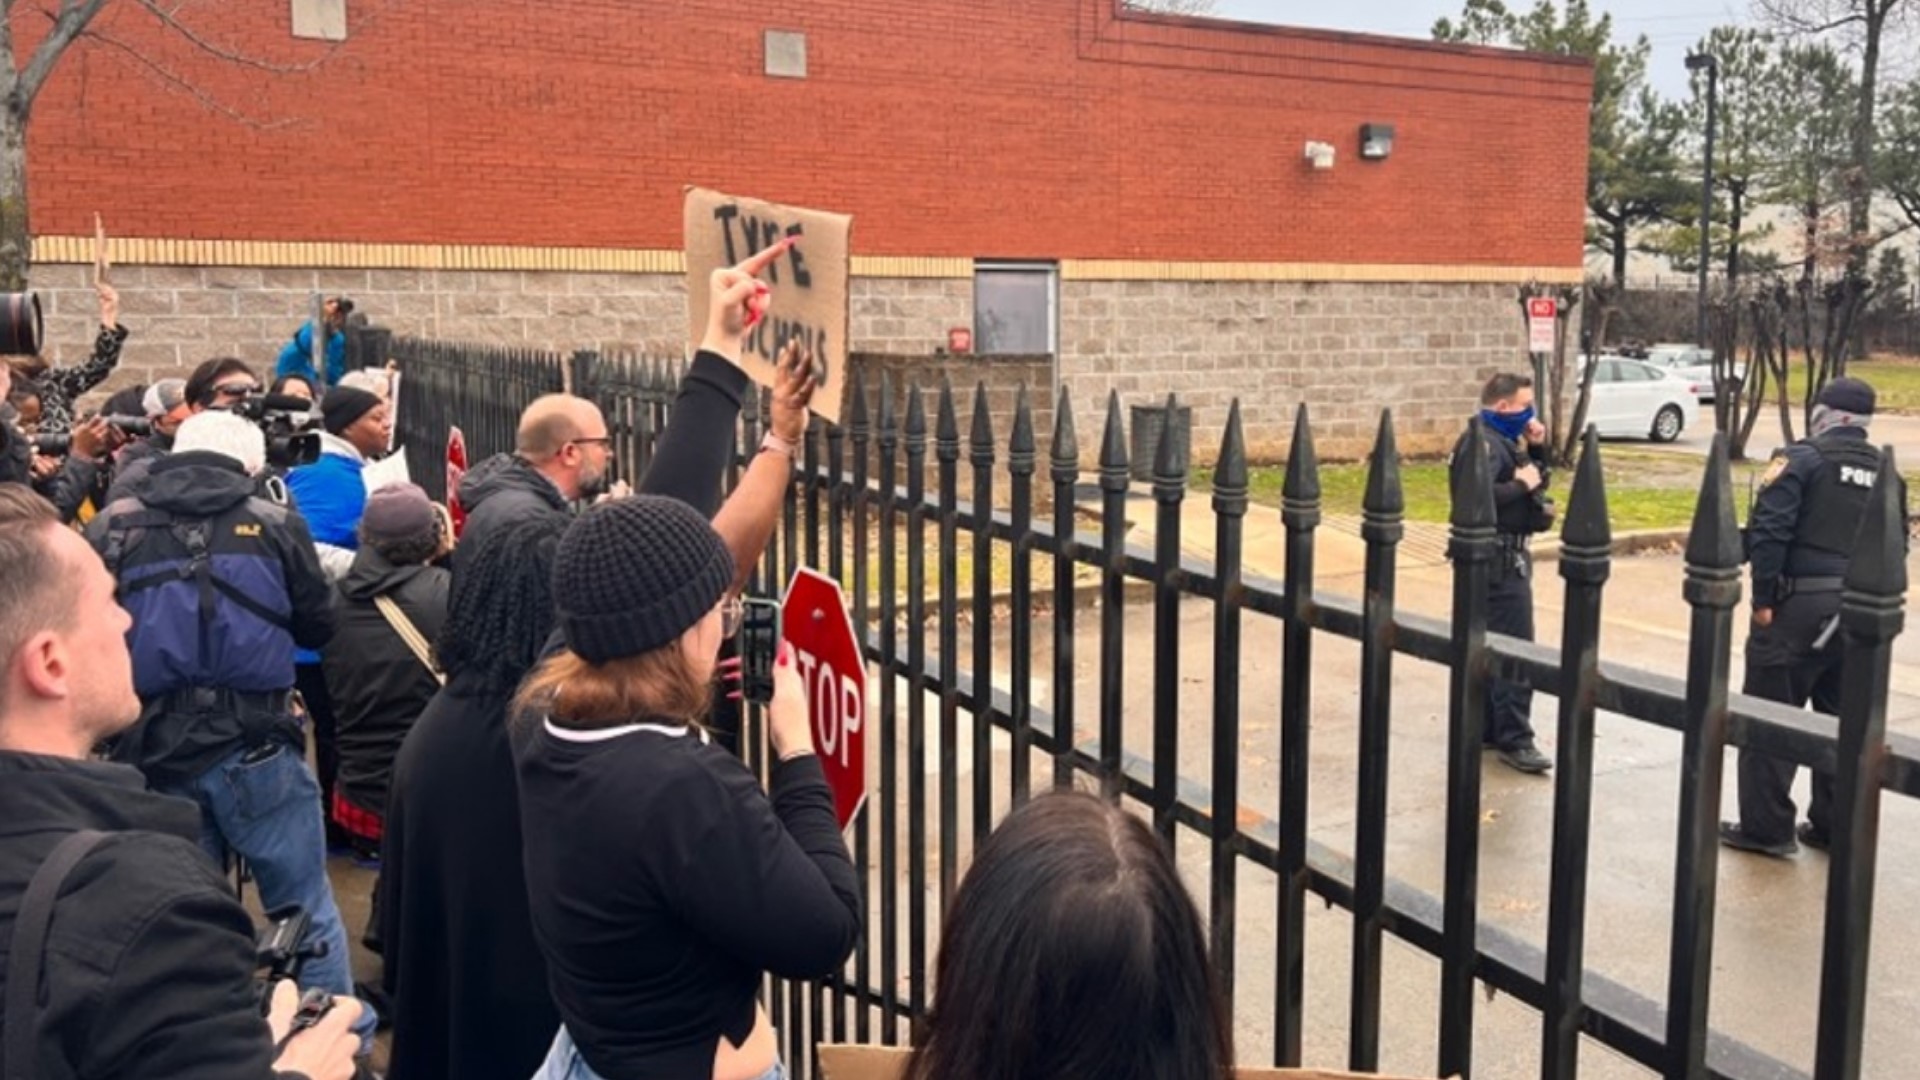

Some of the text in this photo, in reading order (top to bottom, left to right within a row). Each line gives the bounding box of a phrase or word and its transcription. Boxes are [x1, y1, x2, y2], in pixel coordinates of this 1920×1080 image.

[714, 205, 811, 288] TYRE
[741, 314, 828, 387] ICHOLS
[798, 648, 861, 768] TOP
